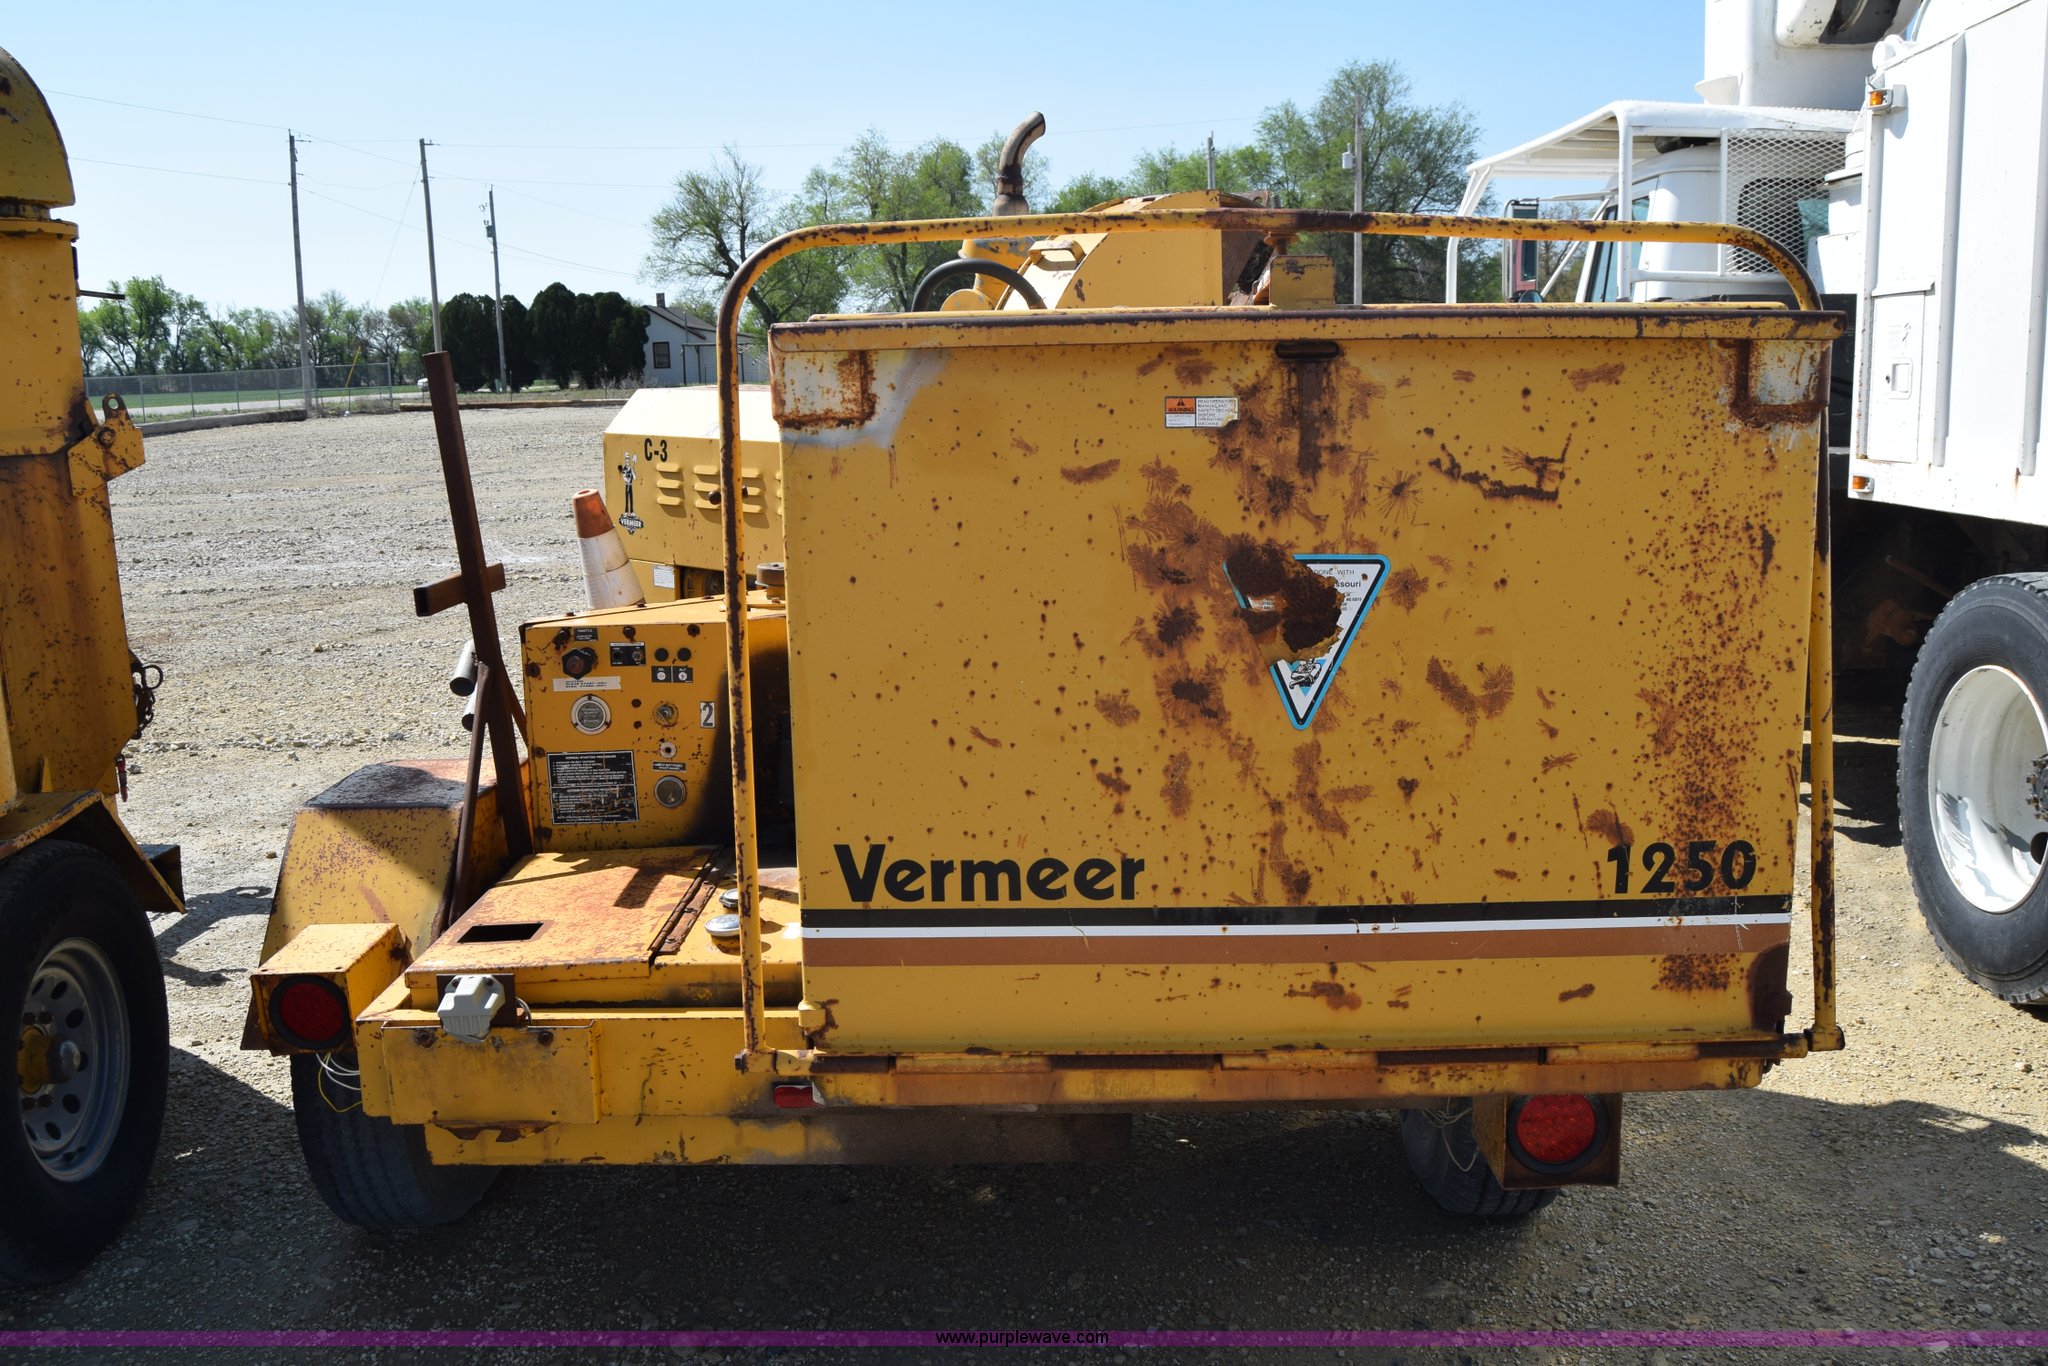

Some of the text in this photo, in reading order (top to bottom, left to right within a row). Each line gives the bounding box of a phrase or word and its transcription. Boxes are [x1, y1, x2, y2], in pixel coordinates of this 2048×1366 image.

[644, 438, 667, 462] C-3
[620, 518, 643, 528] VERMEER
[702, 702, 714, 727] 2
[833, 843, 1145, 902] Vermeer
[1607, 840, 1757, 894] 1250
